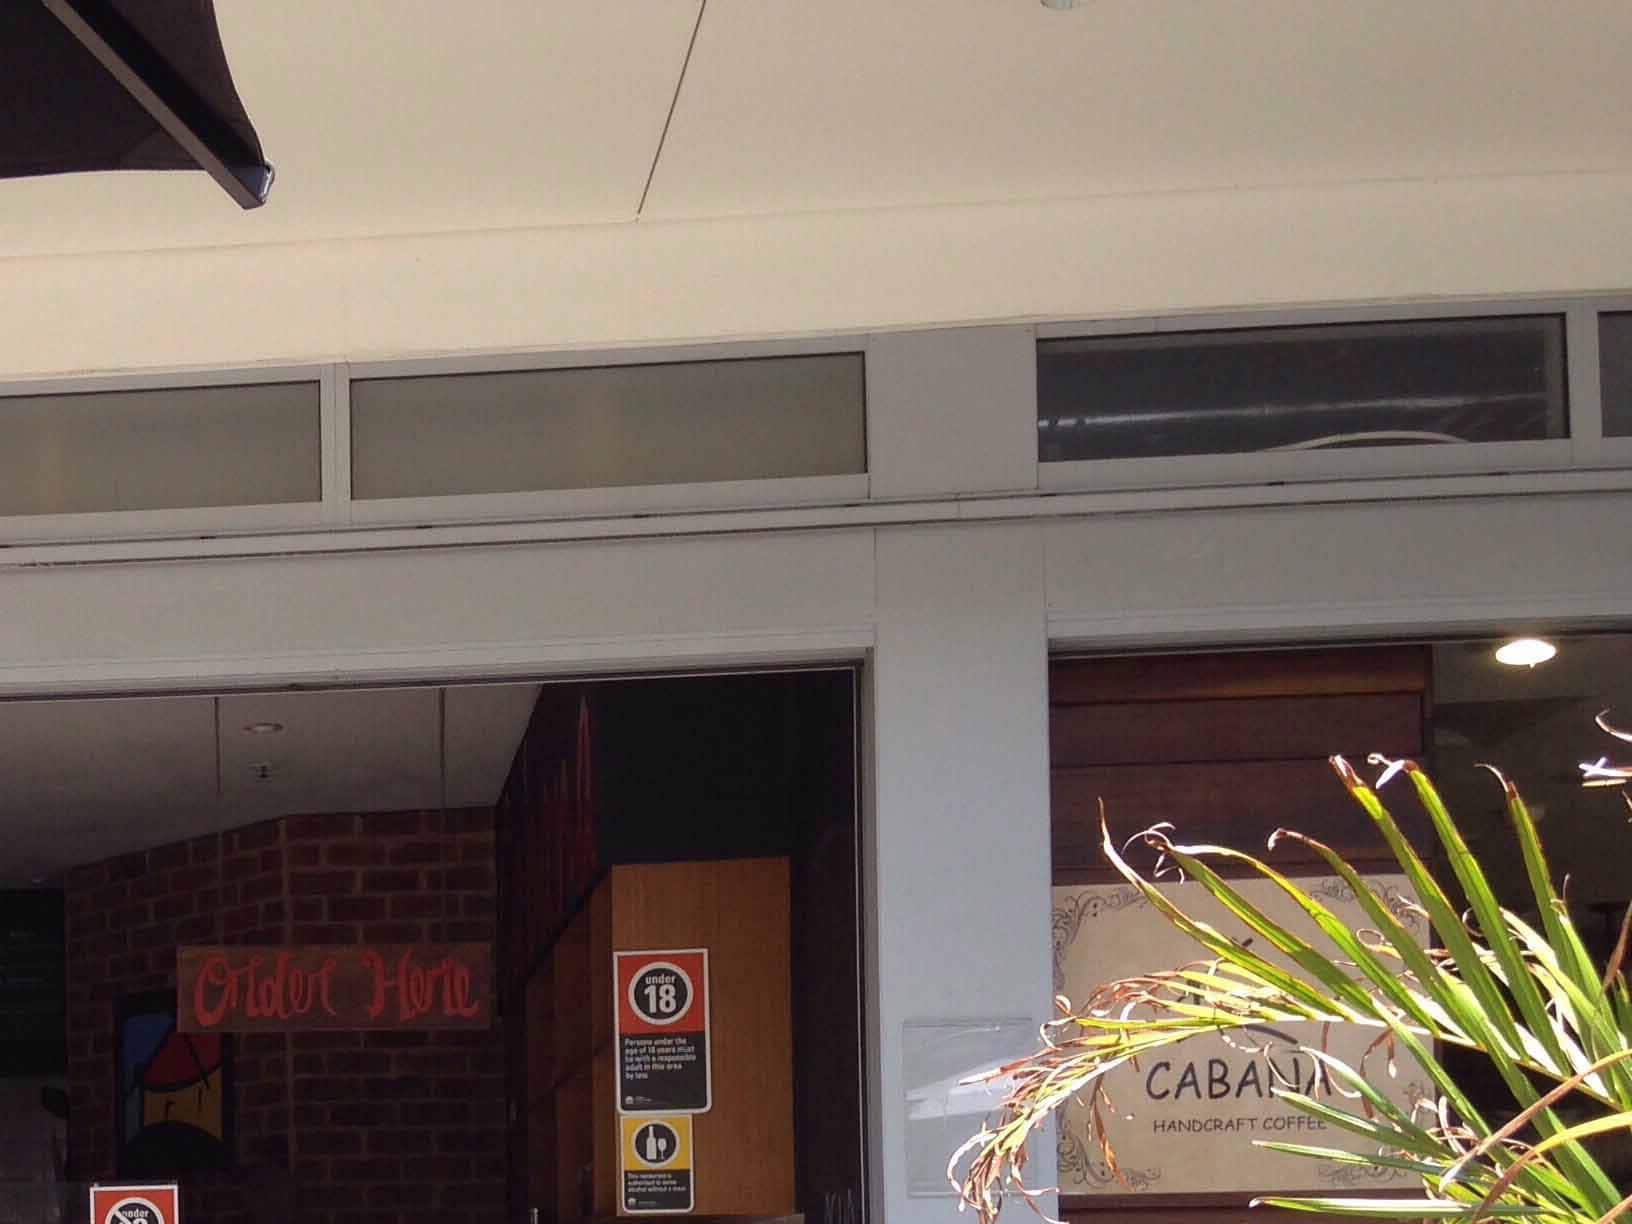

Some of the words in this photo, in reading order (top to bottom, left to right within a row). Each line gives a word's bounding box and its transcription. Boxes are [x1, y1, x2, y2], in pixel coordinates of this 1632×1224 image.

[193, 950, 337, 1027] Order
[360, 949, 480, 1022] Here
[645, 973, 676, 985] under
[643, 985, 678, 1014] 18
[1146, 1056, 1332, 1100] CABANA
[1153, 1117, 1258, 1134] HANDCRAFT
[1263, 1115, 1327, 1131] COFFEE
